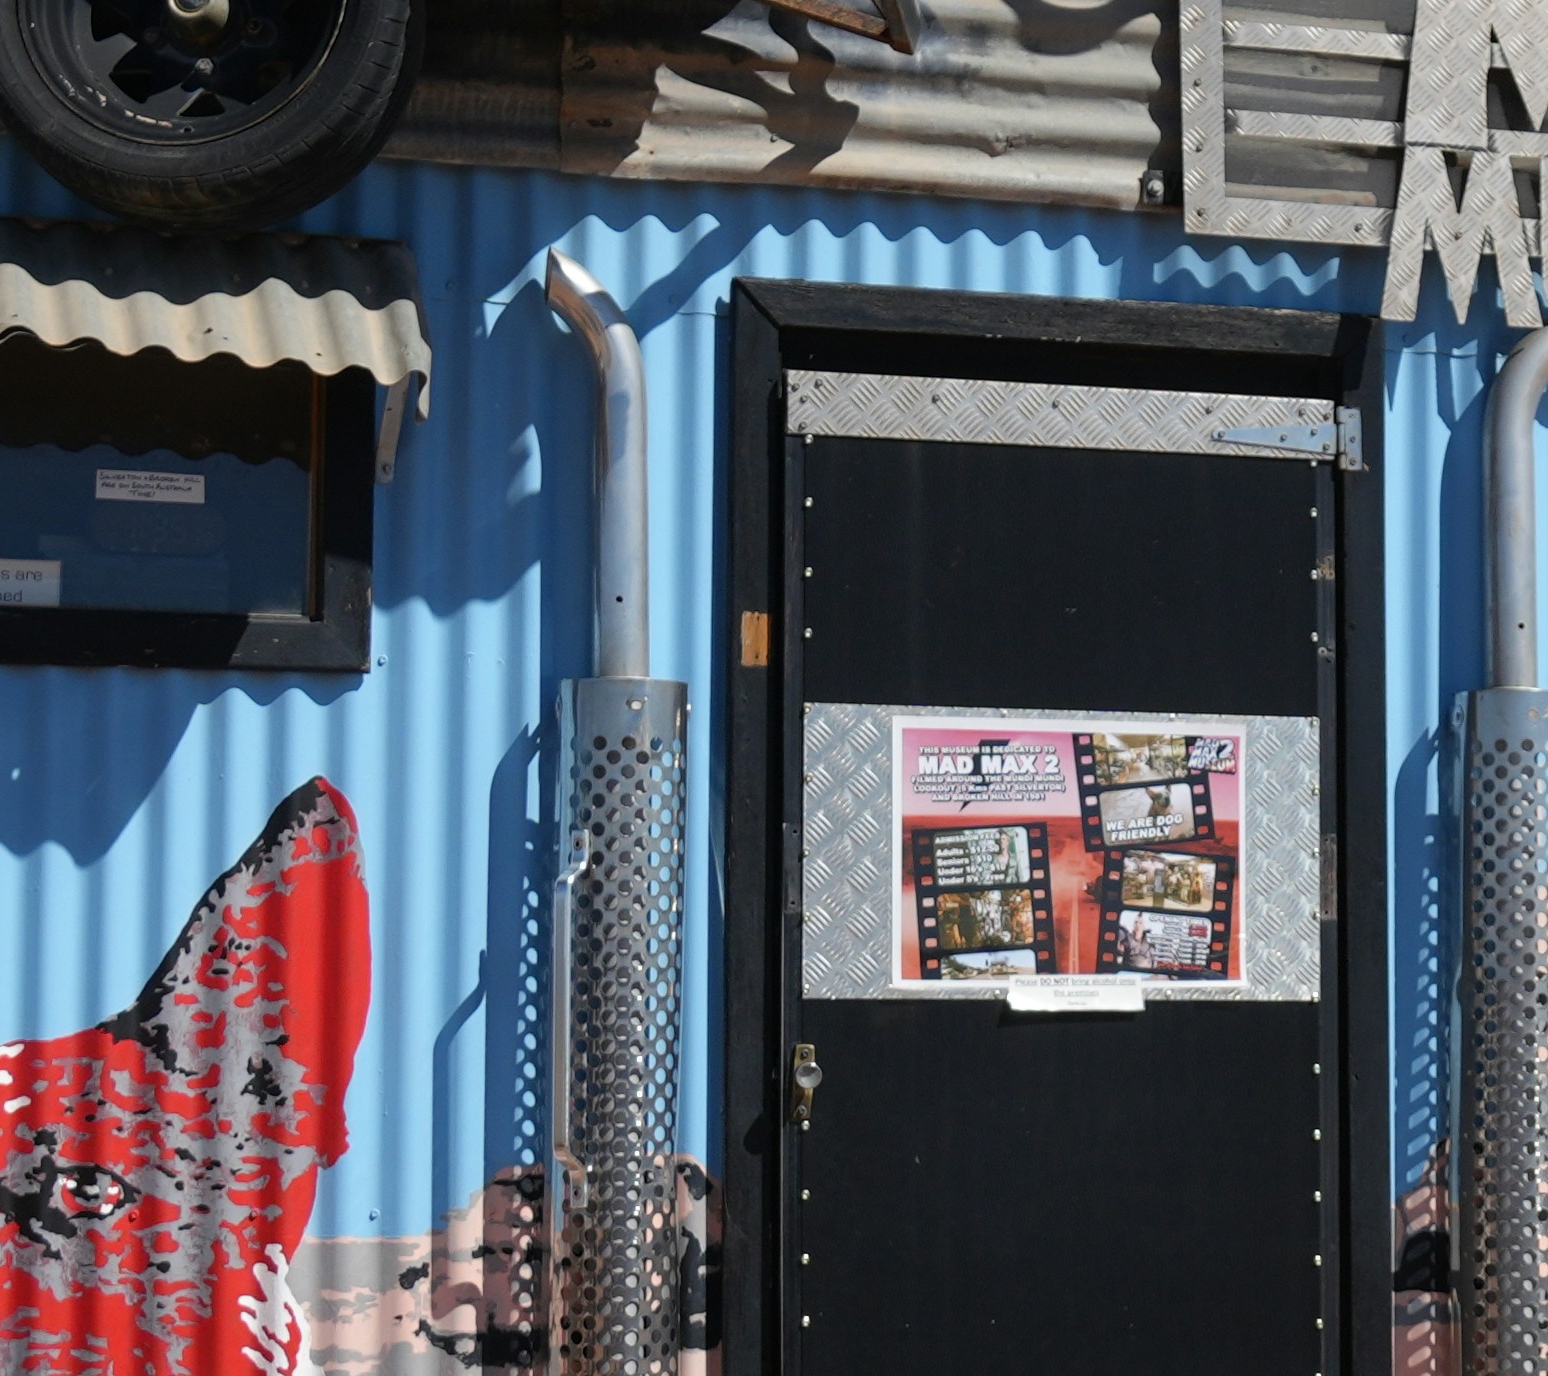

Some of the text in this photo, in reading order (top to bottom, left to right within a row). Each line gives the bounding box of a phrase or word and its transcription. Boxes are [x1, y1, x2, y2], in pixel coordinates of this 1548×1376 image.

[15, 569, 43, 581] are
[942, 746, 980, 754] MUSEUM
[918, 755, 1061, 775] MAD MAX 2
[1106, 813, 1184, 831] WE ARE DOG
[1111, 825, 1172, 842] FRIENDLY
[1040, 977, 1051, 985] DO
[1053, 977, 1070, 985] NOT
